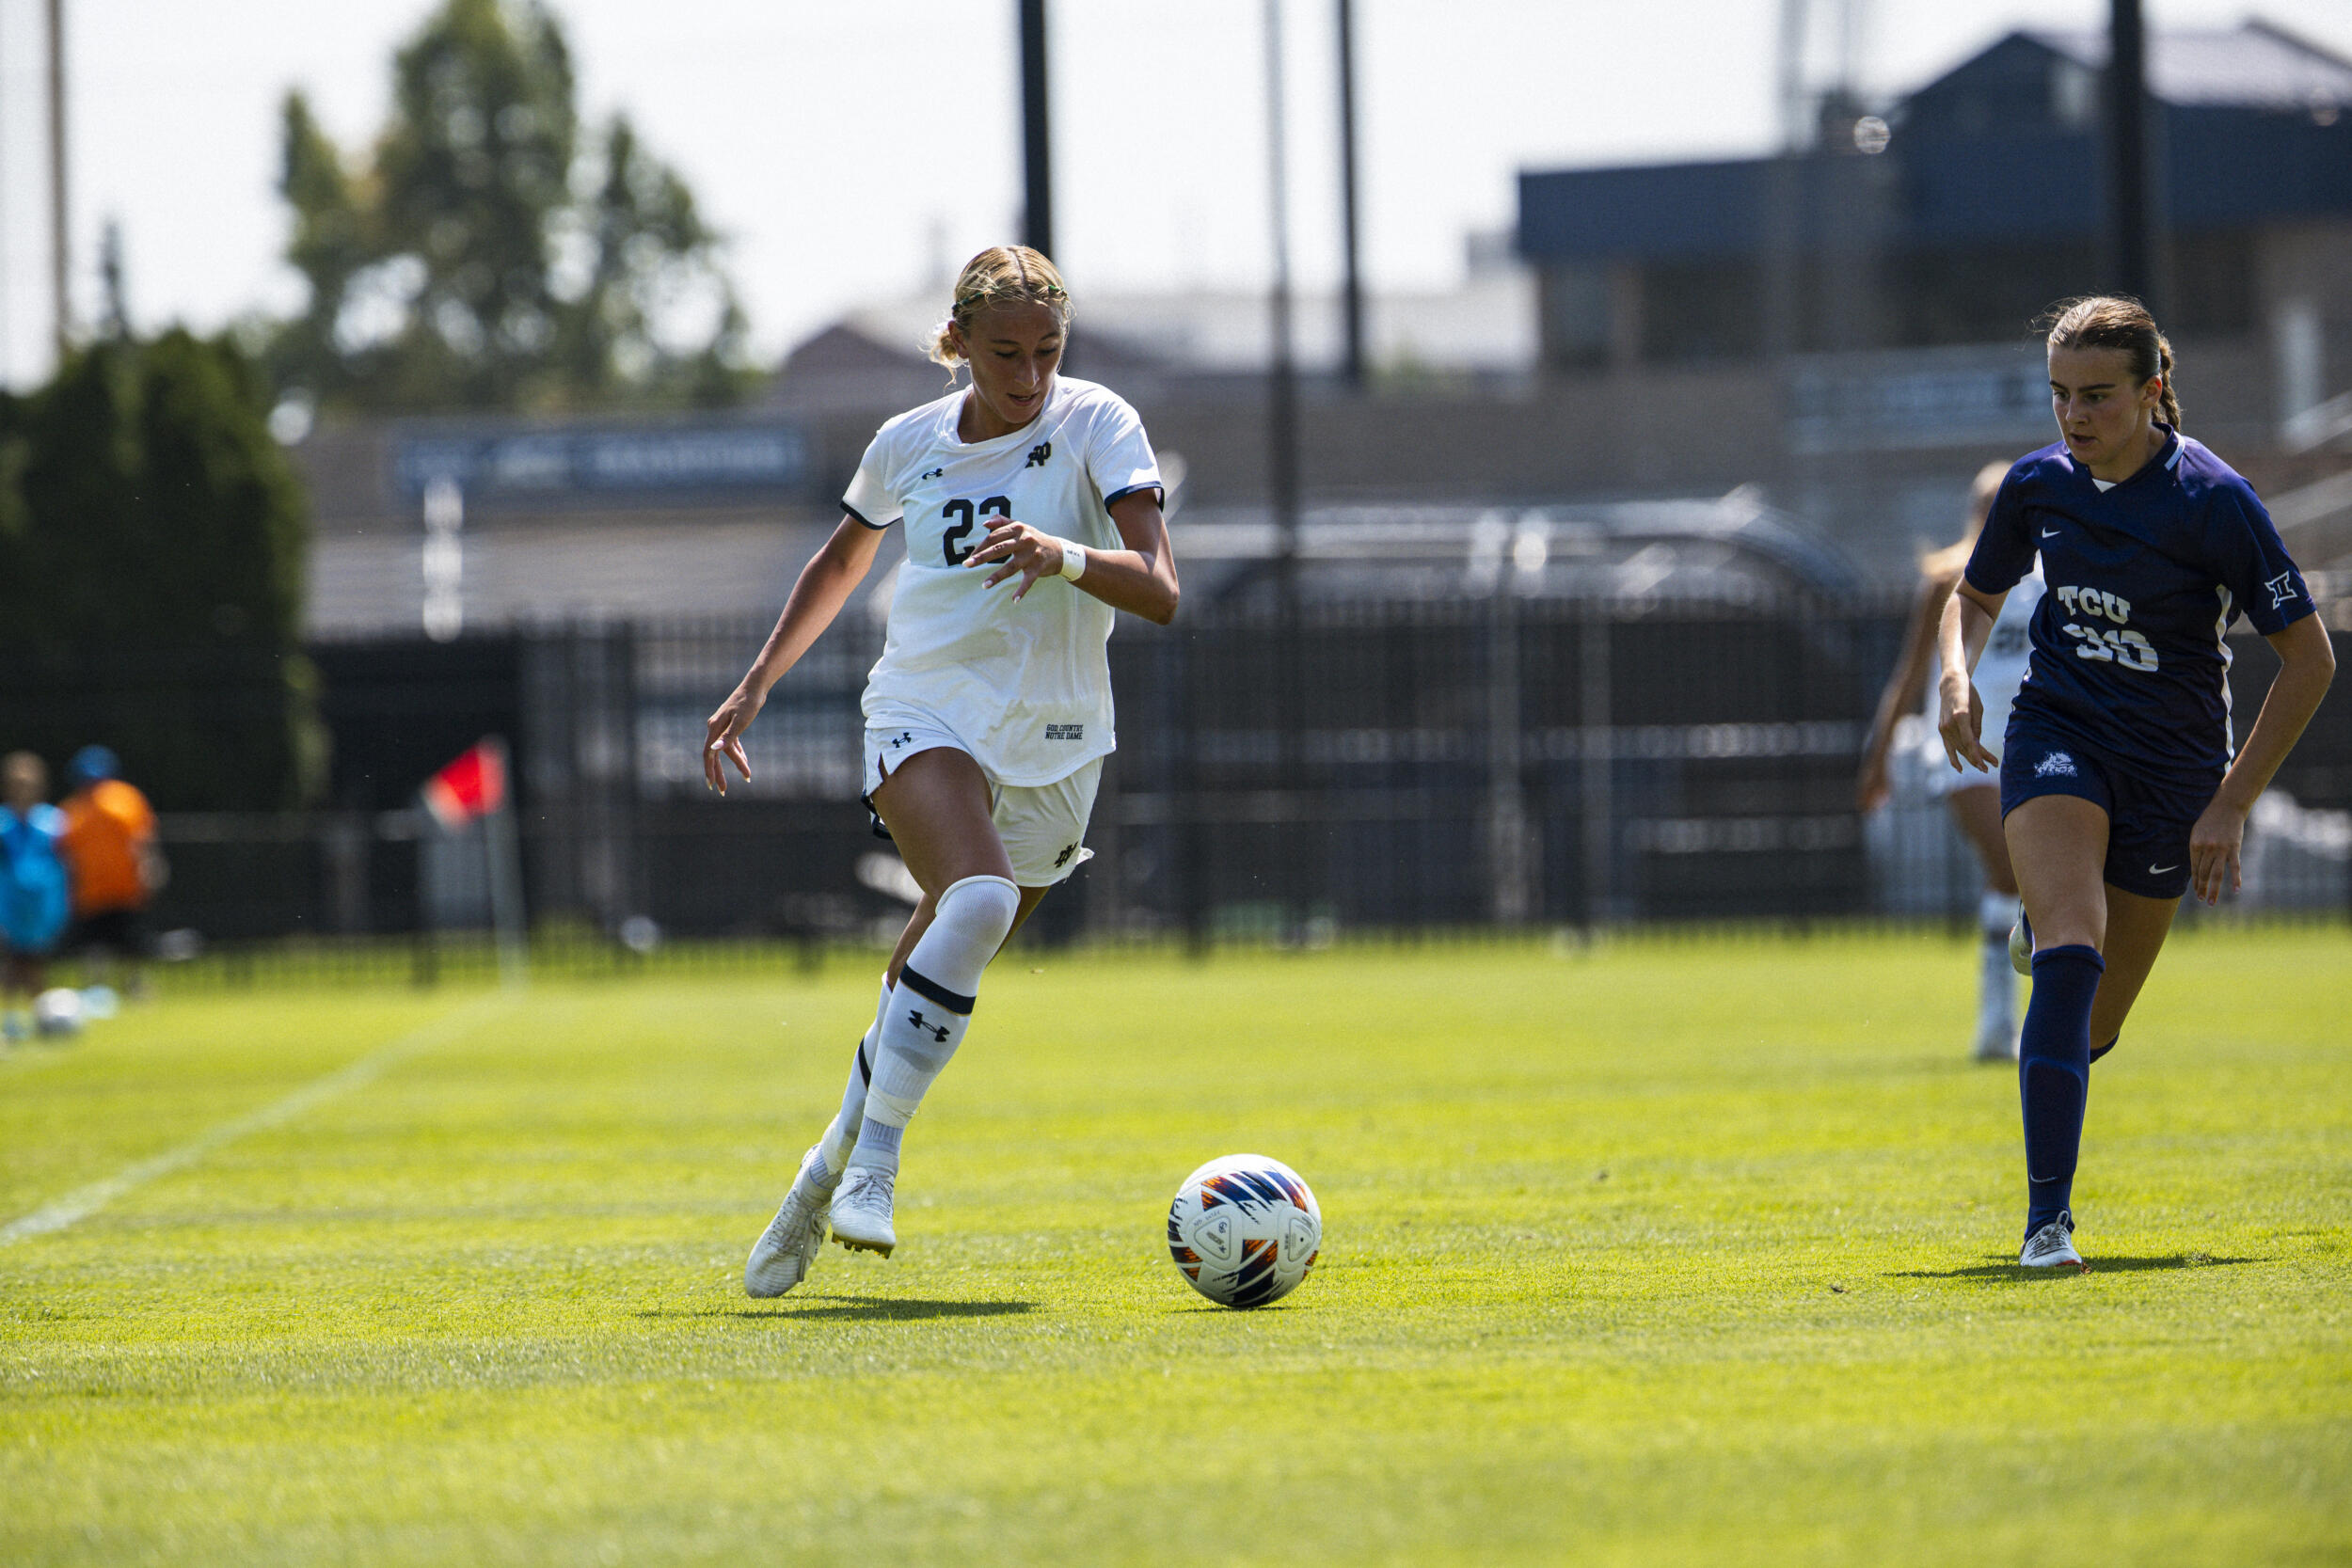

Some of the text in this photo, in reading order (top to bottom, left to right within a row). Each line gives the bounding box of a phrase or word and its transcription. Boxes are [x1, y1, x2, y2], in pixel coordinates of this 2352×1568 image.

[2058, 585, 2130, 625] TCU
[2062, 623, 2158, 672] 30
[1045, 731, 1065, 739] NOTRE
